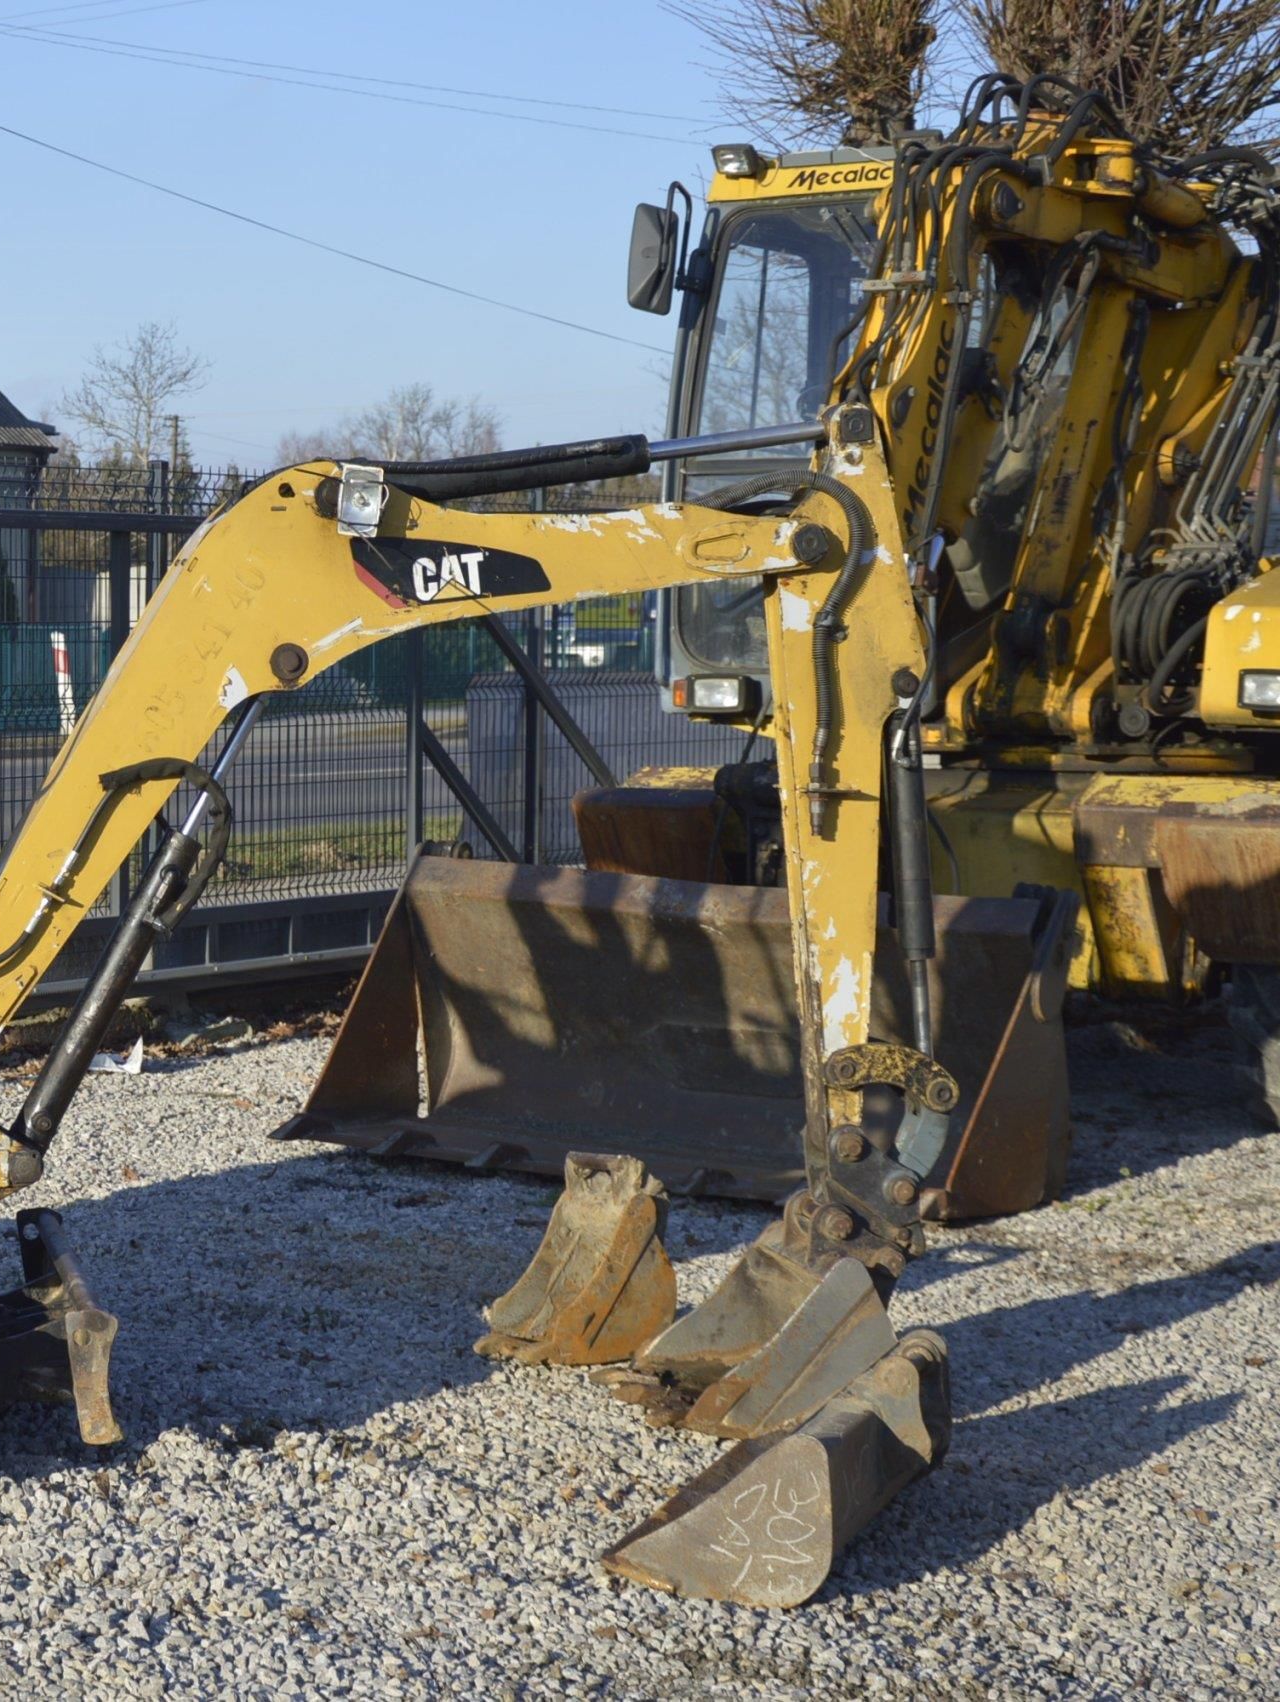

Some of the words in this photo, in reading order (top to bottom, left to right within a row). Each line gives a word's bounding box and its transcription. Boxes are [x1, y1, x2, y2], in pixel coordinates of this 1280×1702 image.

[787, 165, 893, 191] Mecalac
[903, 320, 954, 536] Mecalac
[412, 552, 484, 602] CAT
